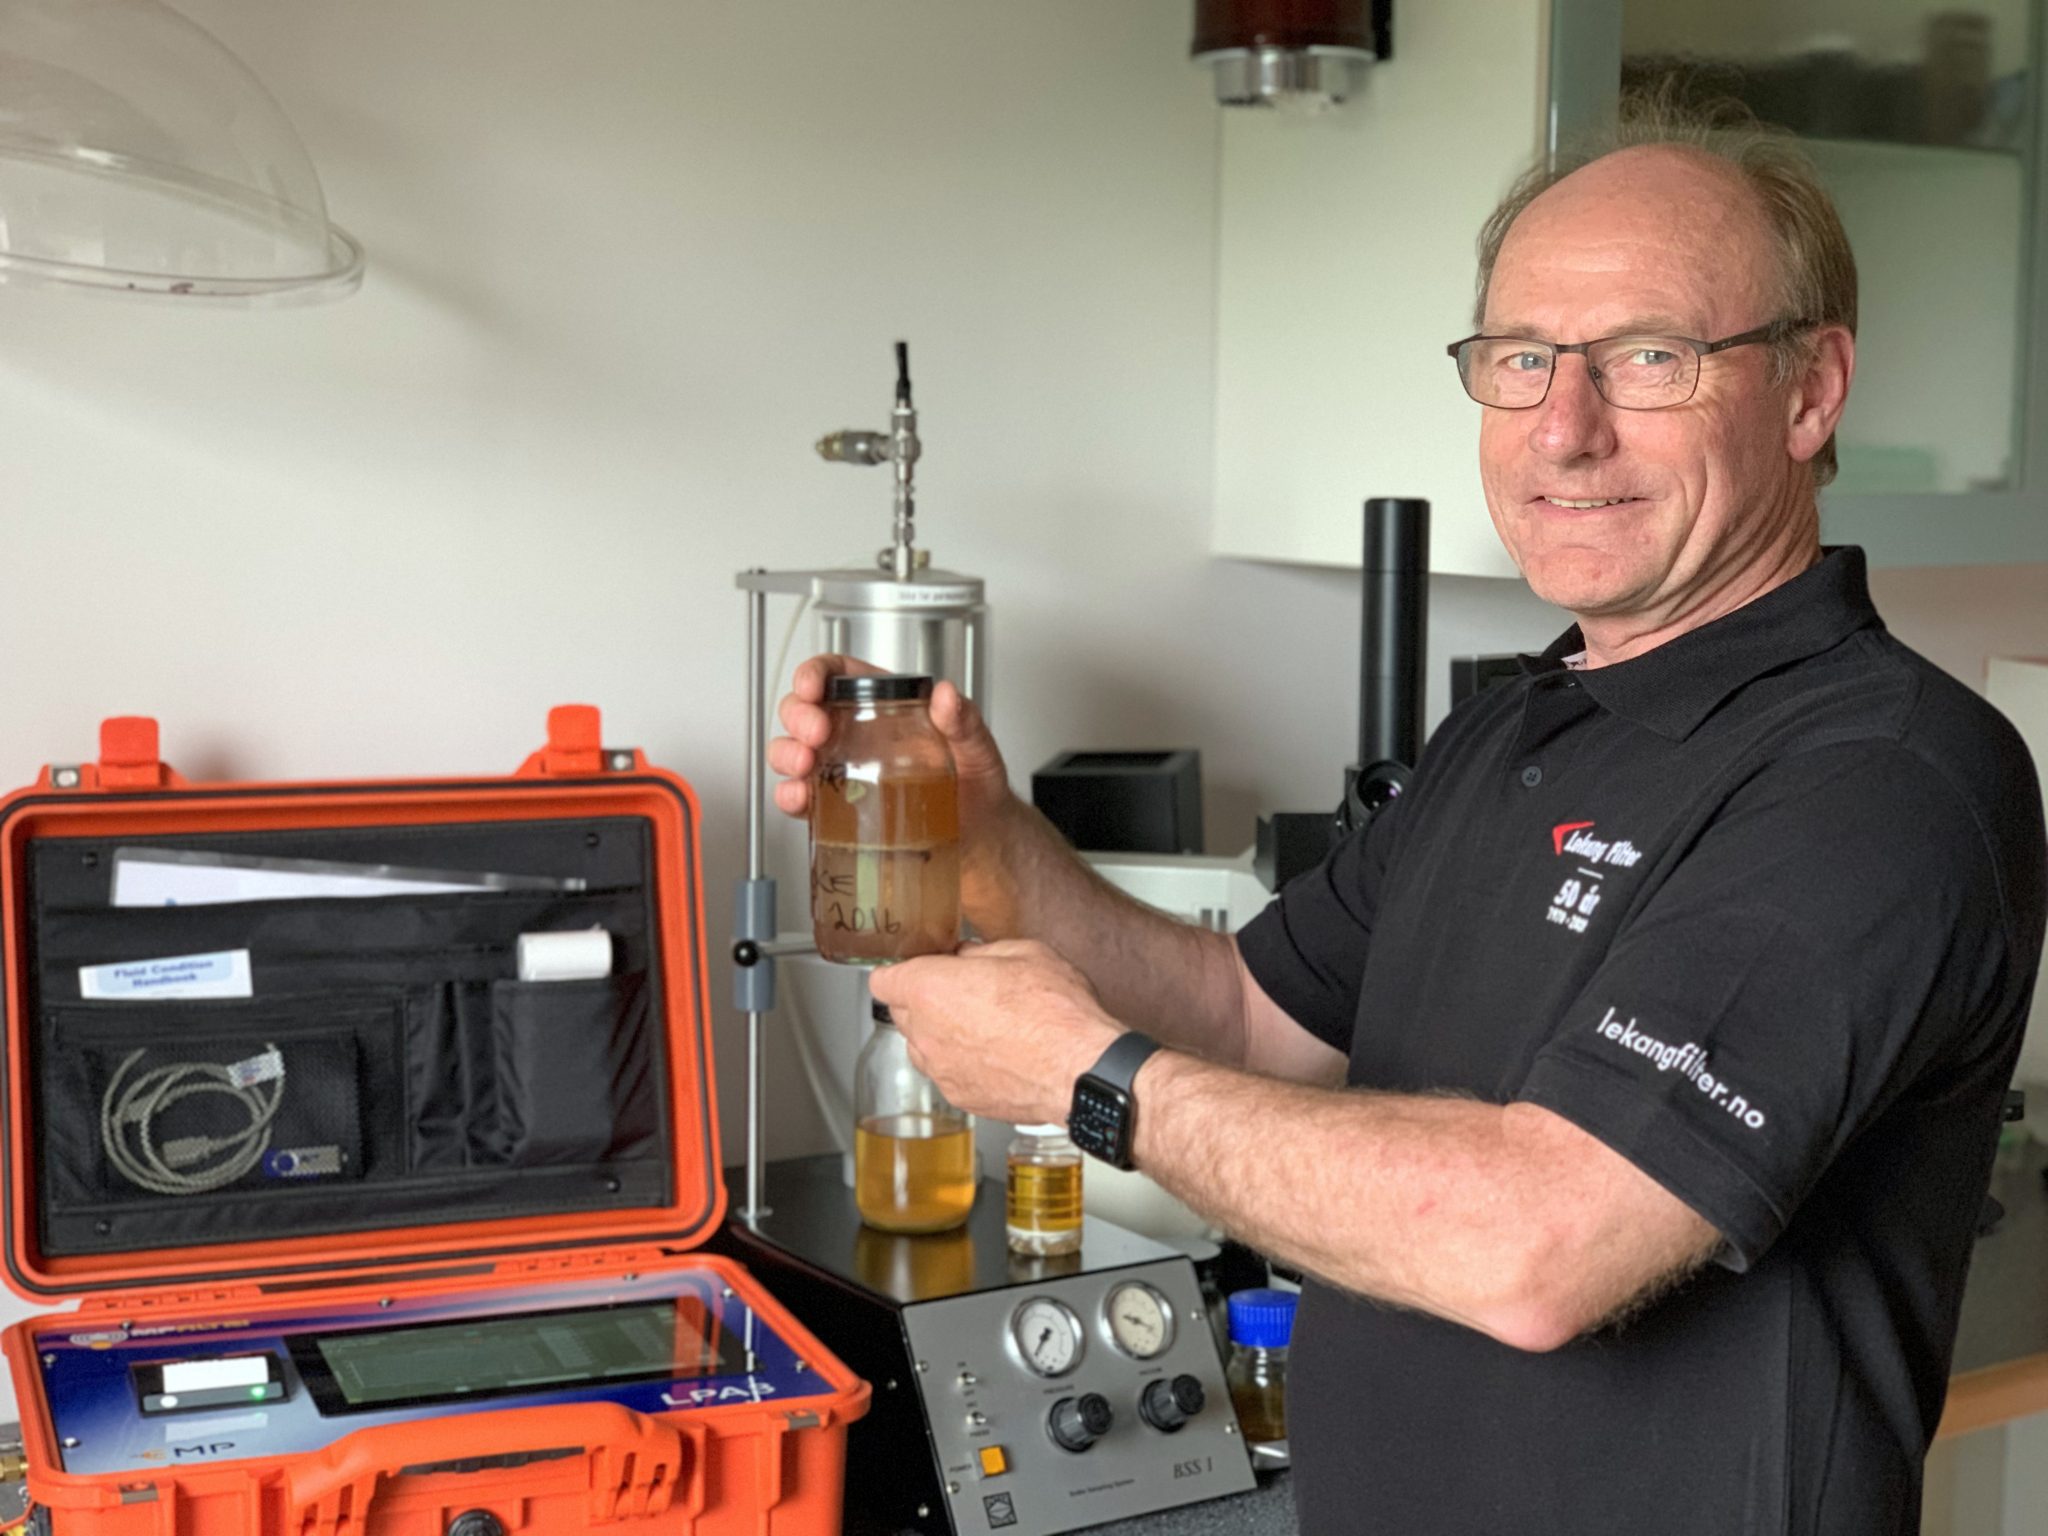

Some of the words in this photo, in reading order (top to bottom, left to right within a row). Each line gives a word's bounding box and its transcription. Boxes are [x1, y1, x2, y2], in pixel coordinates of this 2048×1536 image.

[828, 902, 902, 935] 2016
[114, 966, 146, 979] Fluid
[152, 960, 213, 974] Condition
[132, 973, 197, 988] Handbook
[1596, 1006, 1765, 1129] lekangfilter.no
[173, 1441, 236, 1458] MP
[1173, 1458, 1203, 1480] BSS
